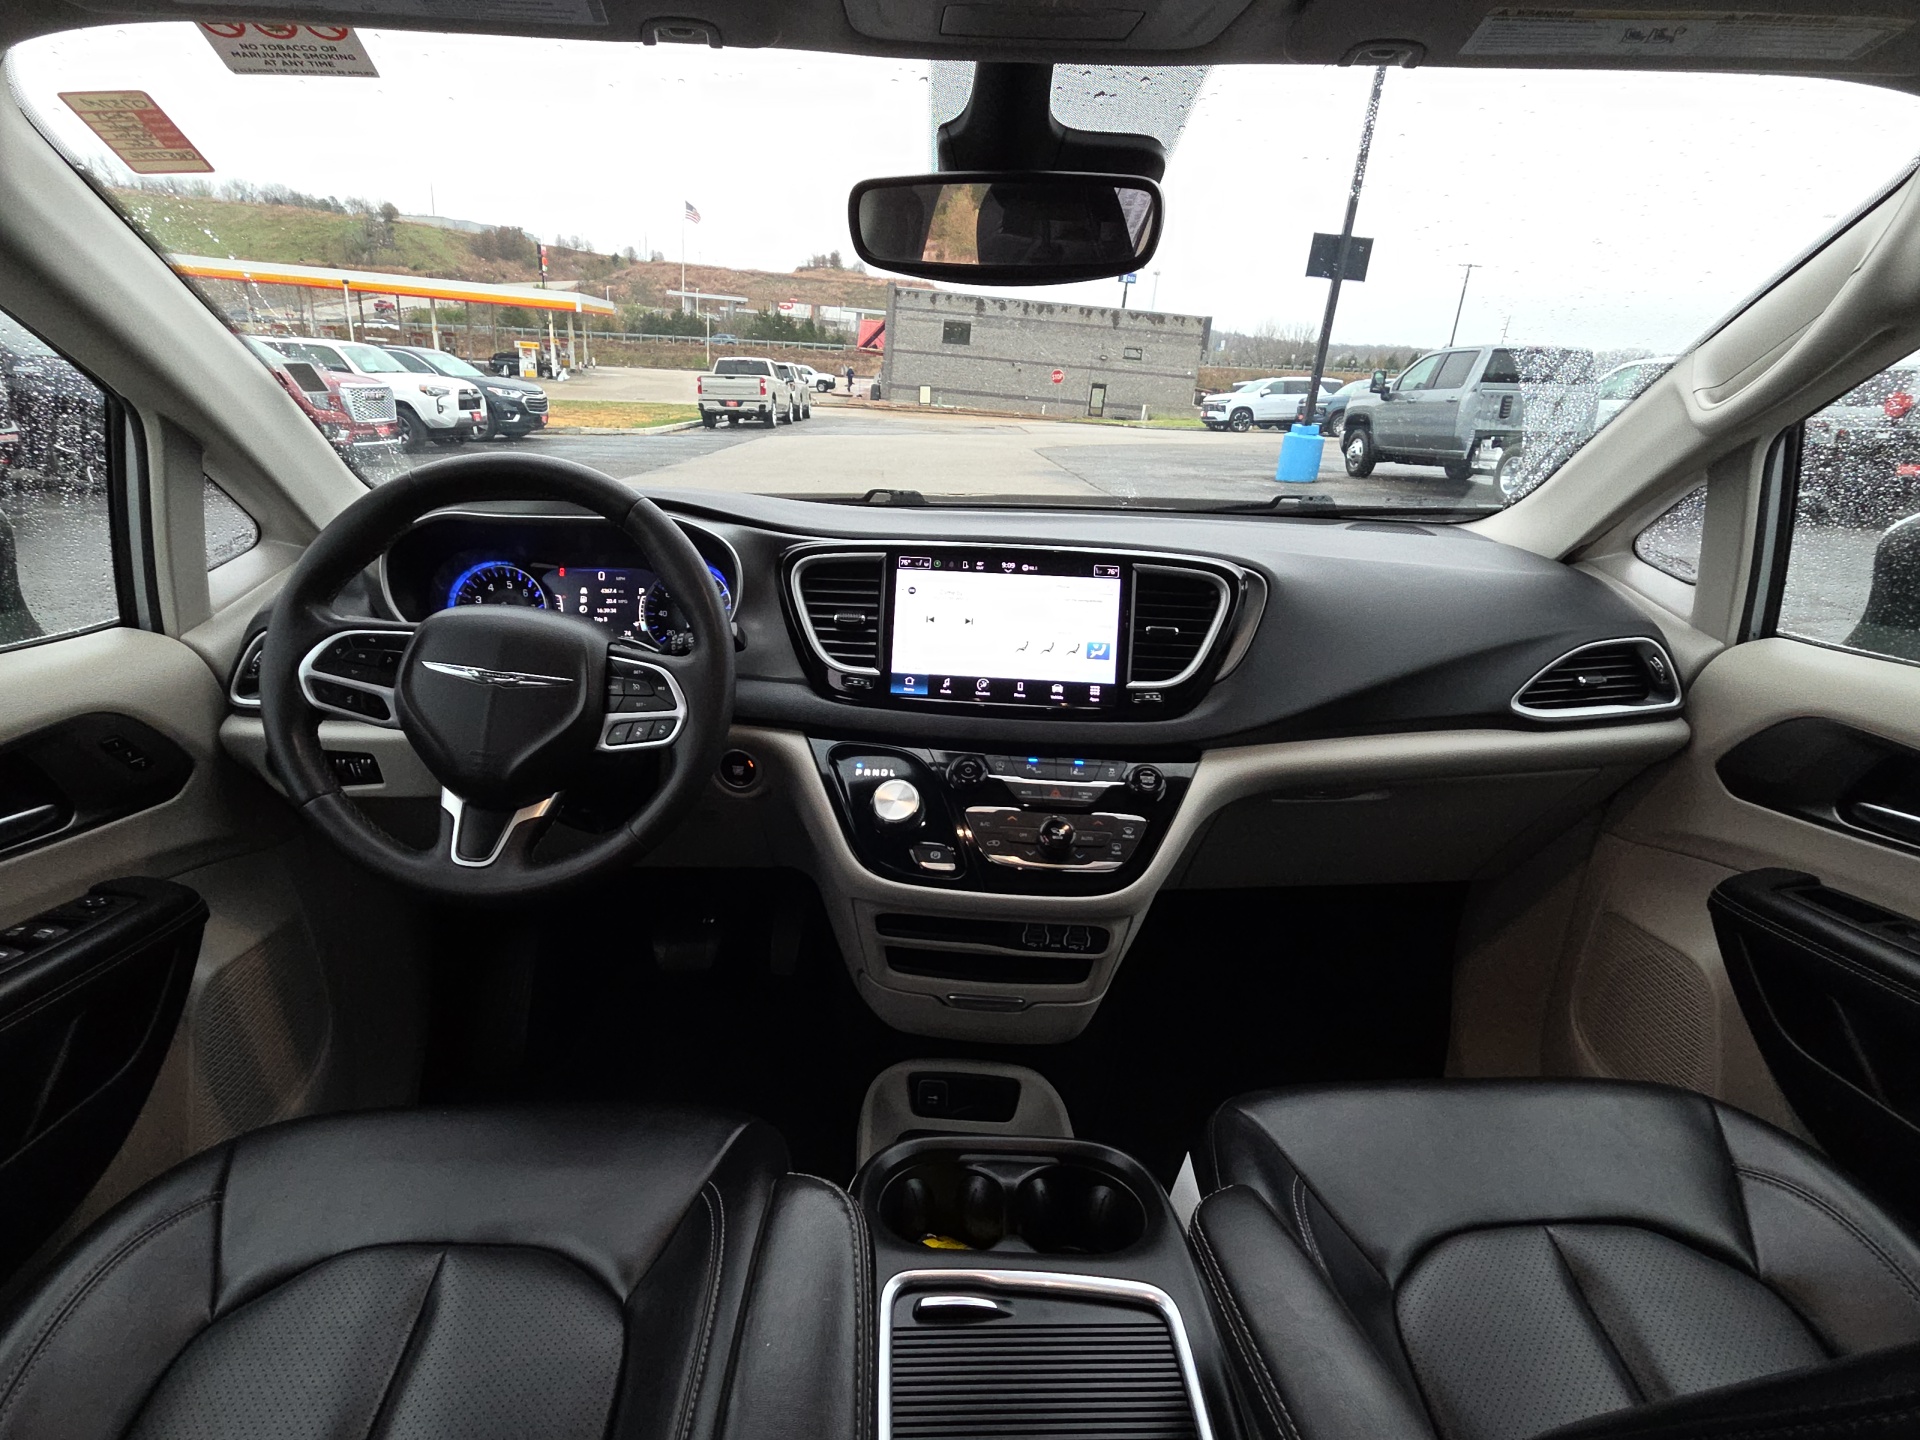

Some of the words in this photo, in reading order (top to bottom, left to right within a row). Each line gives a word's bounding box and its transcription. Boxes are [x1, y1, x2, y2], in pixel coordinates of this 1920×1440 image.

[231, 51, 301, 59] MARIJUANA
[303, 53, 356, 61] SMOKING
[598, 571, 606, 581] 0
[487, 583, 495, 592] 4
[506, 581, 513, 589] 5
[522, 589, 529, 597] 6
[638, 587, 645, 595] P
[475, 595, 482, 604] 3
